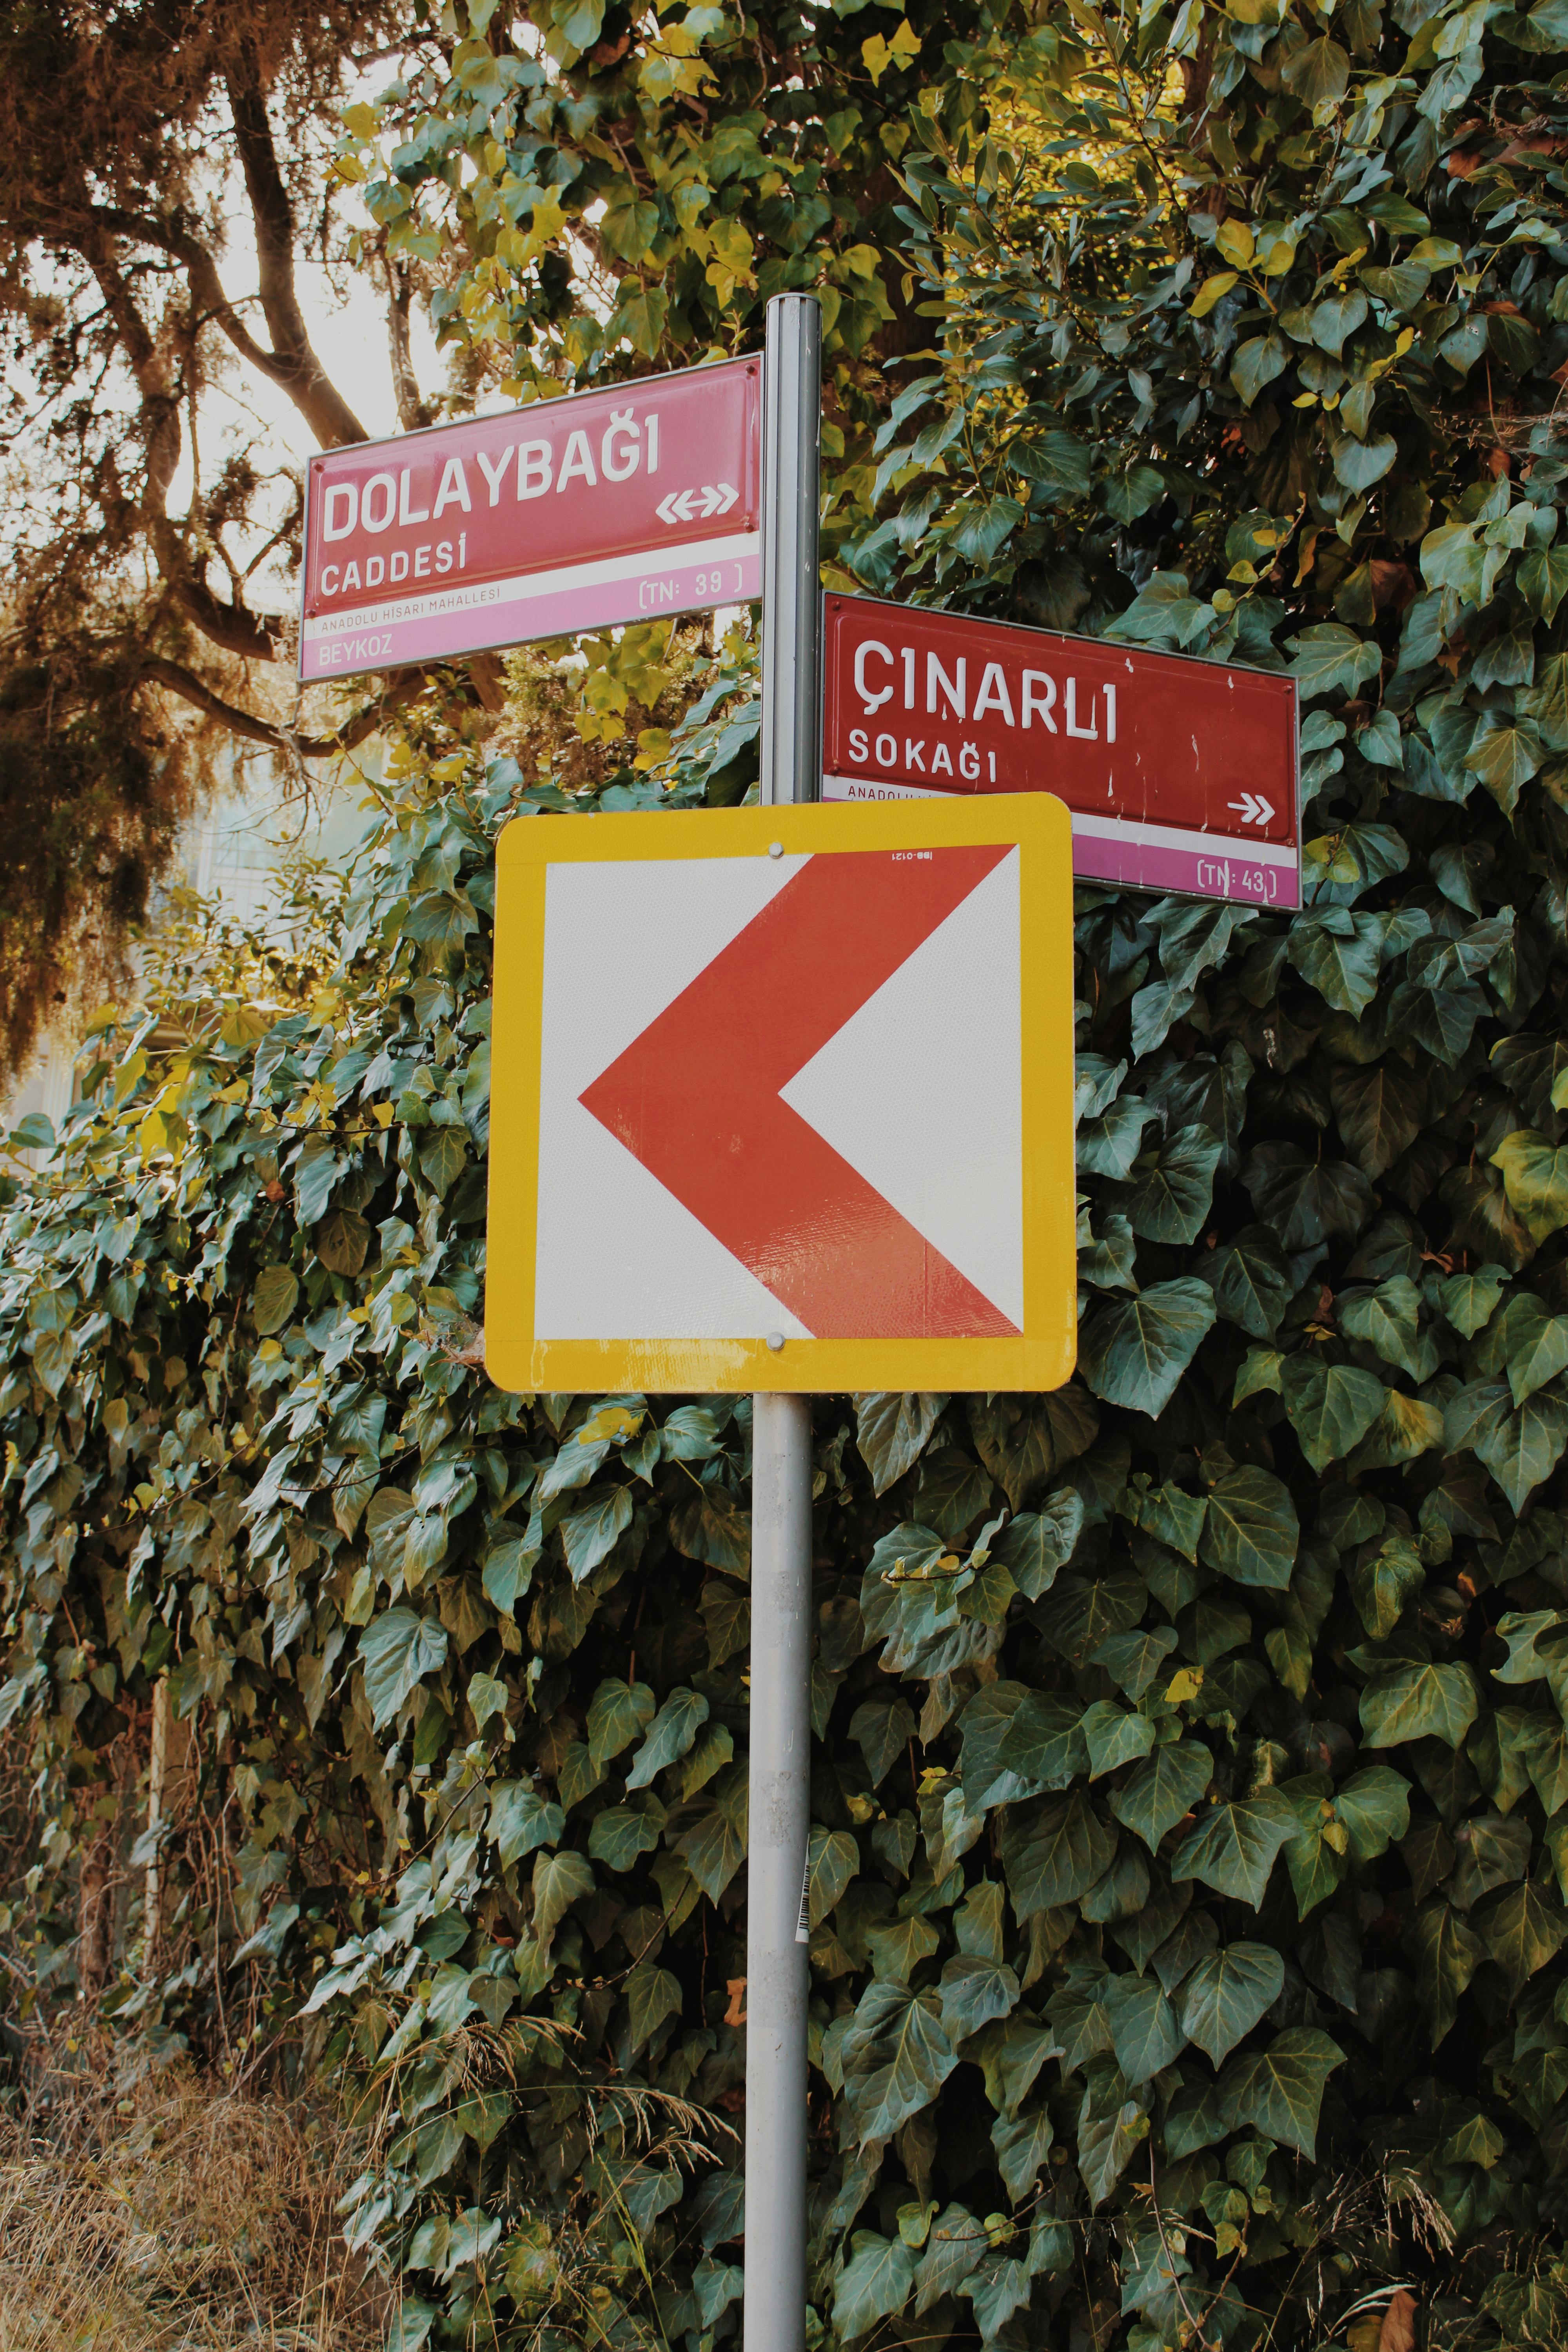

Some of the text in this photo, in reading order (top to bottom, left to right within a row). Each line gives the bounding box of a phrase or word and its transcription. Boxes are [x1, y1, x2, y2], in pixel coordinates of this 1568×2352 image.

[323, 407, 659, 542] DOLAYBAĞI
[321, 532, 466, 595] CADDESİ
[639, 579, 679, 609] (TN:
[695, 571, 722, 595] 39
[322, 586, 500, 632] ANADOLU HİSARI MAHALLESİ
[319, 633, 392, 666] BEYKOZ
[854, 640, 1116, 743] ÇINARLI
[848, 729, 996, 782] SOKAĞI
